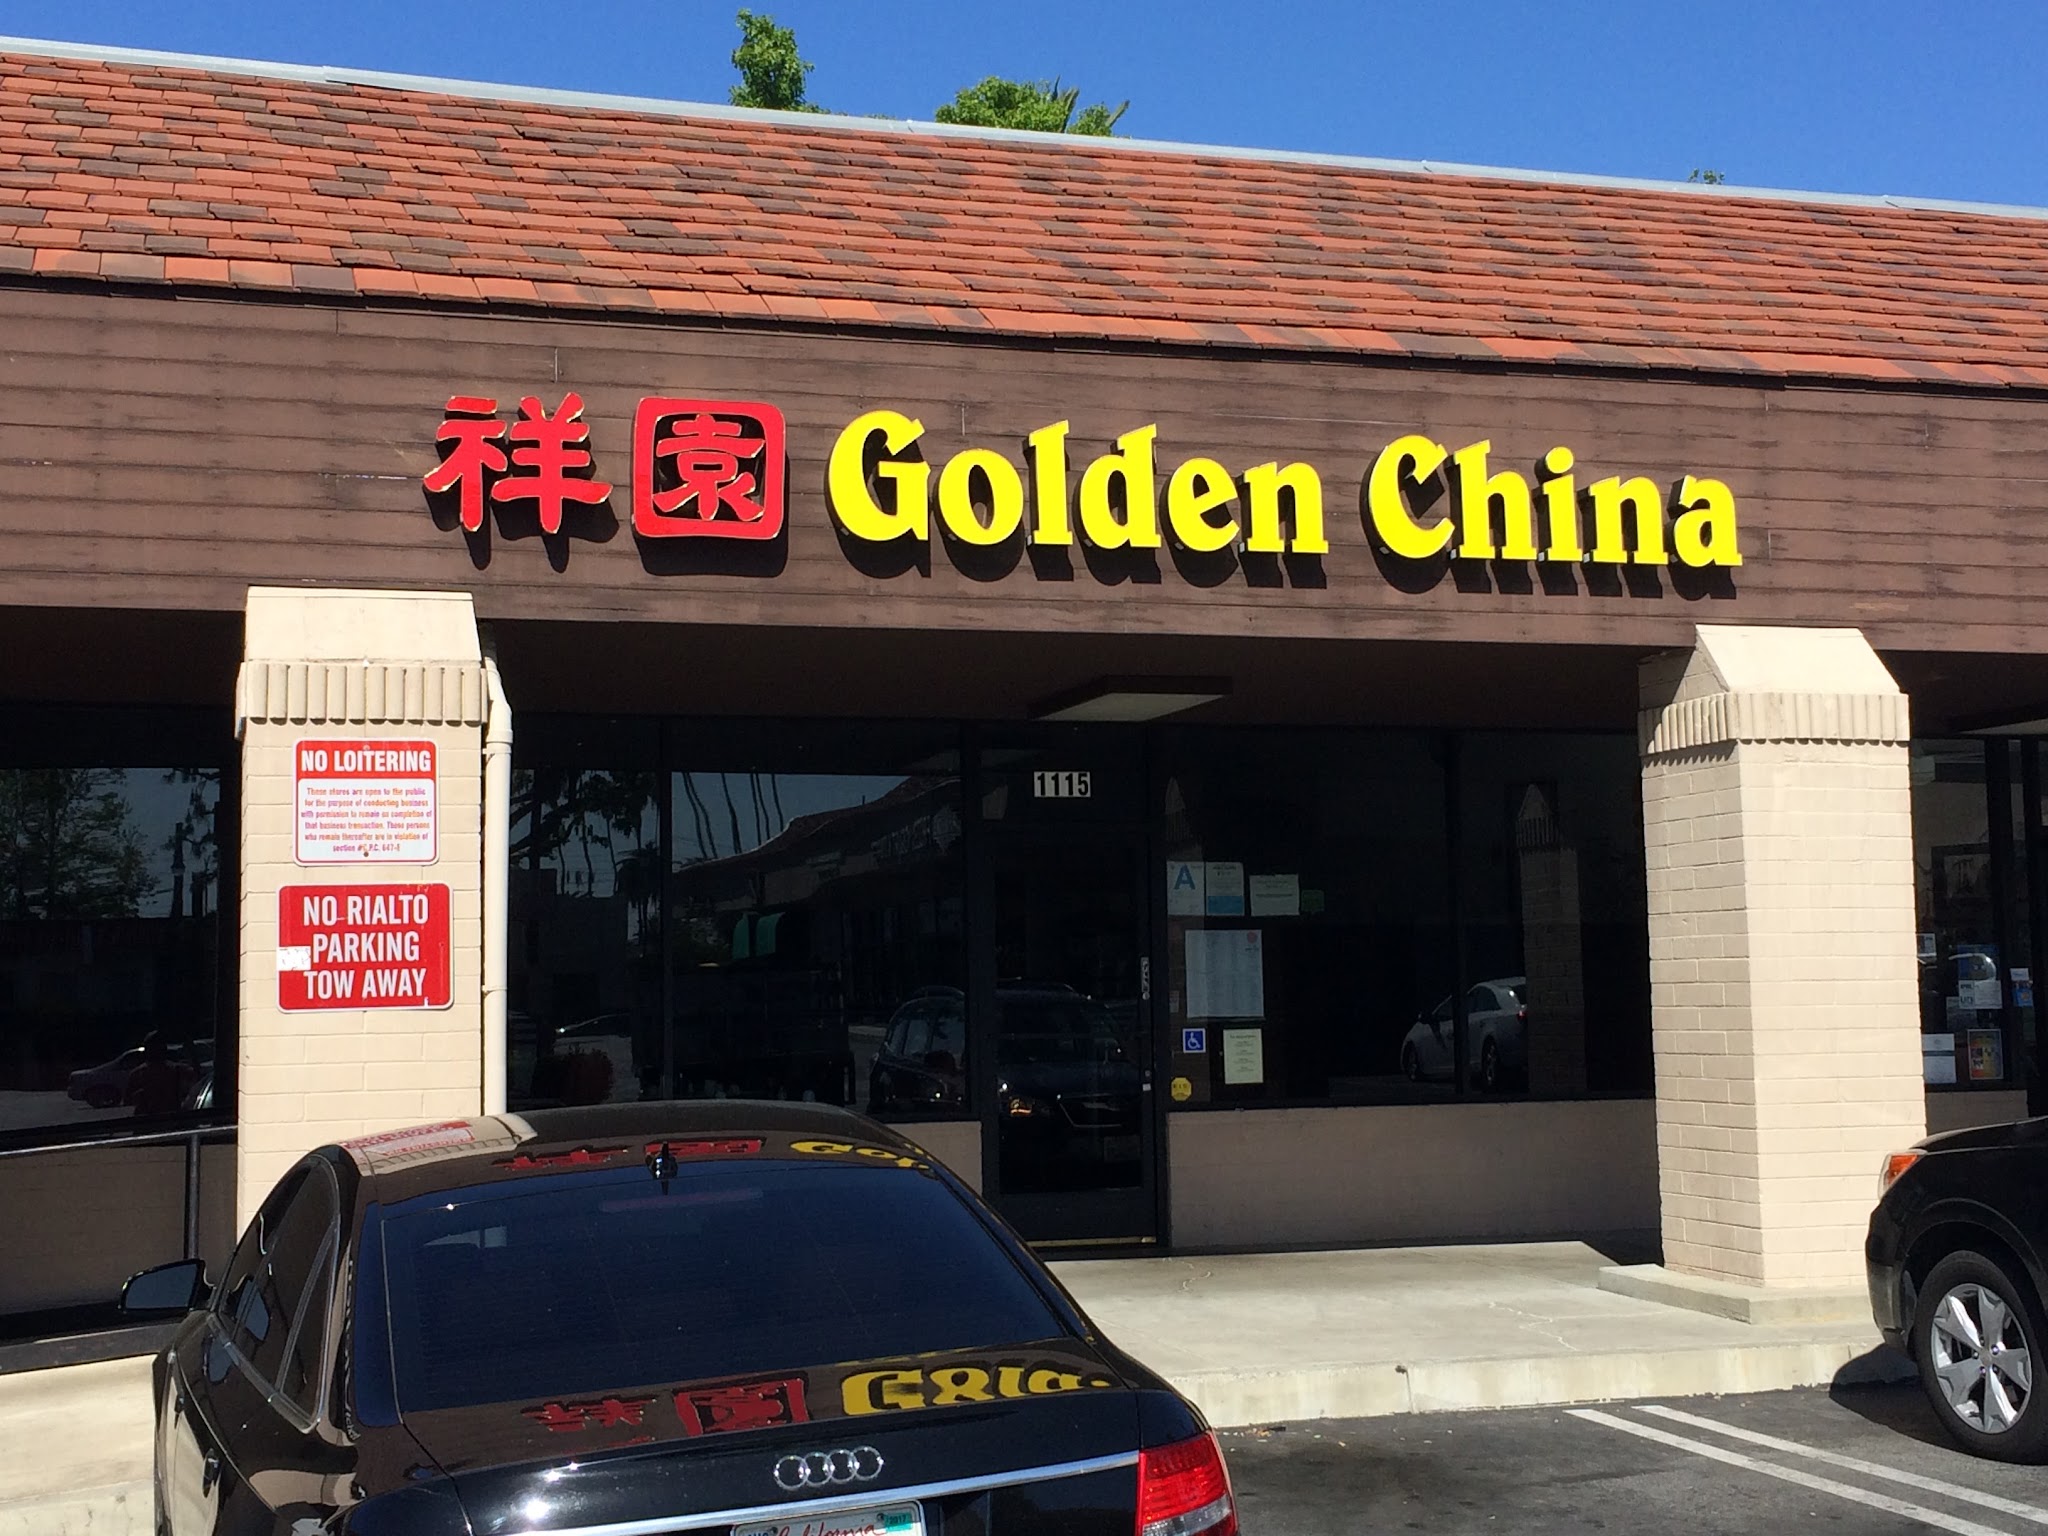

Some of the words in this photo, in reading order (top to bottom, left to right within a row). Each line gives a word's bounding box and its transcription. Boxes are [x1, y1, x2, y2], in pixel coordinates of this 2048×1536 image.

[829, 410, 1328, 555] Golden
[1368, 434, 1742, 567] China
[301, 750, 327, 772] NO
[334, 750, 431, 772] LOITERING
[329, 788, 350, 796] stores
[365, 789, 382, 797] open
[383, 788, 390, 796] to
[392, 788, 403, 796] the
[405, 788, 426, 797] public
[1038, 773, 1089, 796] 1115
[305, 799, 314, 807] for
[316, 799, 326, 807] the
[328, 800, 353, 808] purpose
[355, 799, 362, 807] of
[363, 799, 399, 808] conducting
[401, 799, 429, 807] business
[316, 811, 349, 819] permission
[391, 811, 424, 819] completion
[406, 822, 430, 830] persons
[342, 833, 373, 841] thereafter
[394, 833, 421, 841] violation
[1174, 863, 1196, 890] A
[304, 896, 337, 926] NO
[347, 894, 428, 925] RIALTO
[313, 931, 419, 963] PARKING
[304, 970, 355, 999] TOW
[361, 968, 427, 998] AWAY
[779, 1521, 882, 1536] Clfornia
